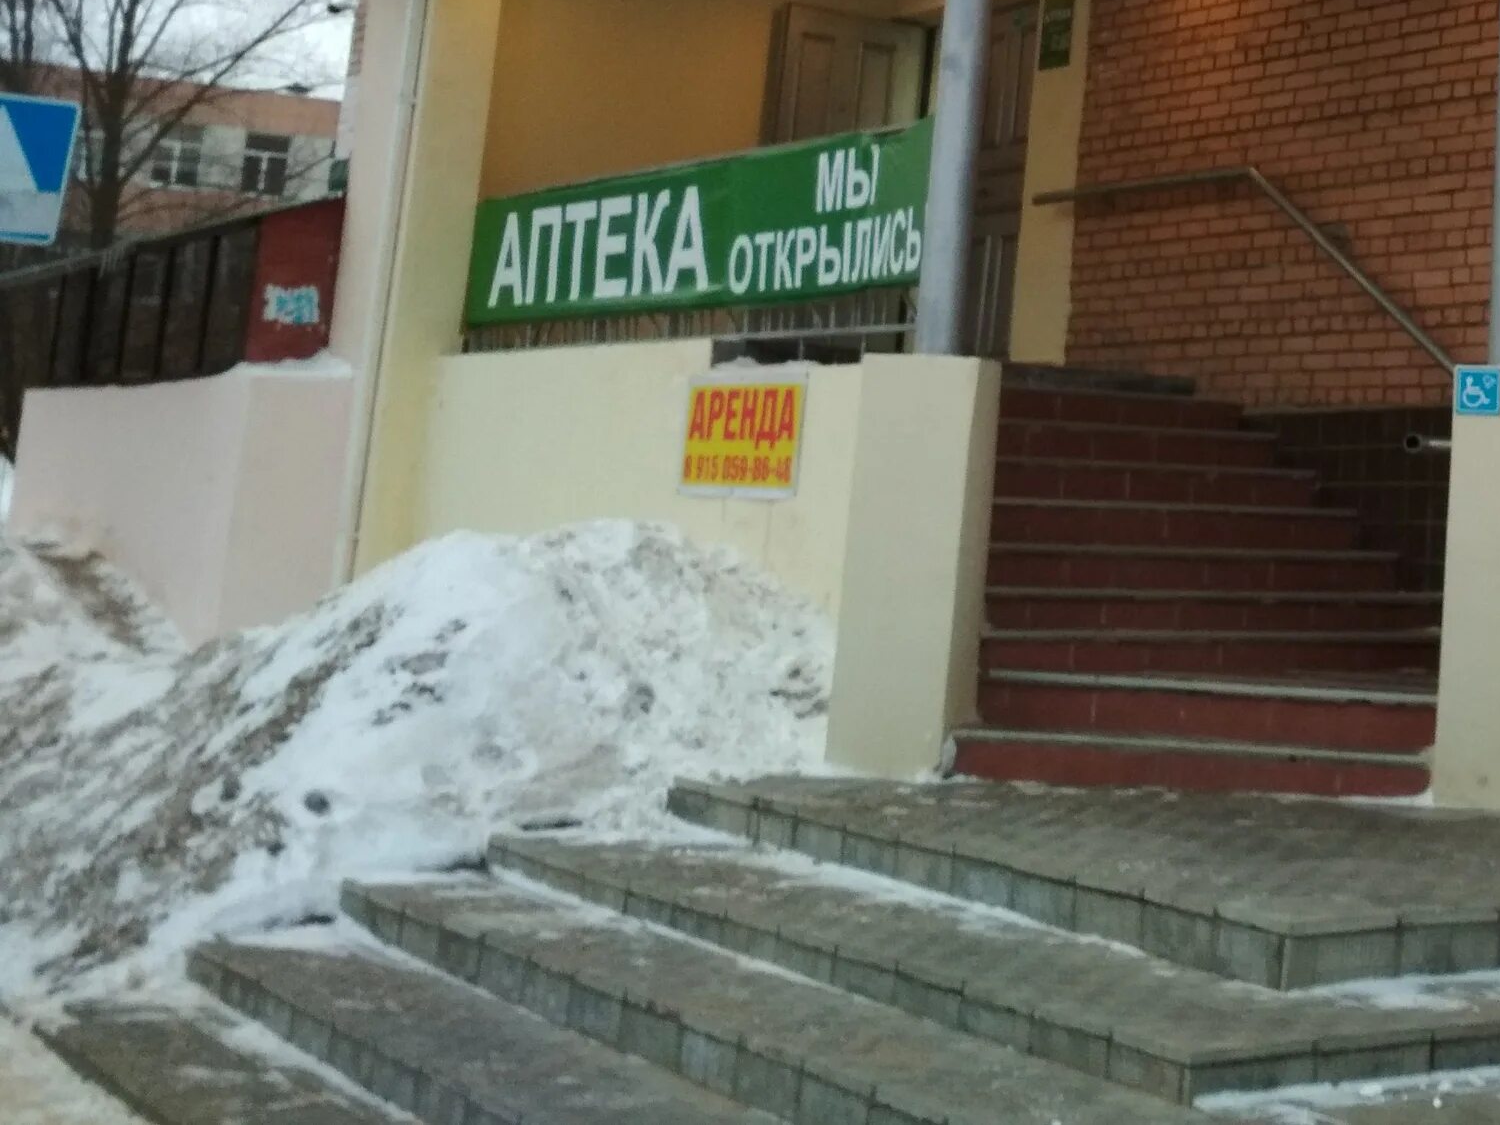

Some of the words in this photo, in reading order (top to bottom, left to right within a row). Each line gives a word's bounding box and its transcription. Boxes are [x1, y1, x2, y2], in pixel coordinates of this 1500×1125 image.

[816, 144, 880, 214] МЫ
[487, 185, 708, 308] АПТЕКА
[729, 206, 921, 295] ОТКРЫЛИСЬ
[688, 387, 795, 450] АРЕНДА
[696, 455, 719, 482] 915
